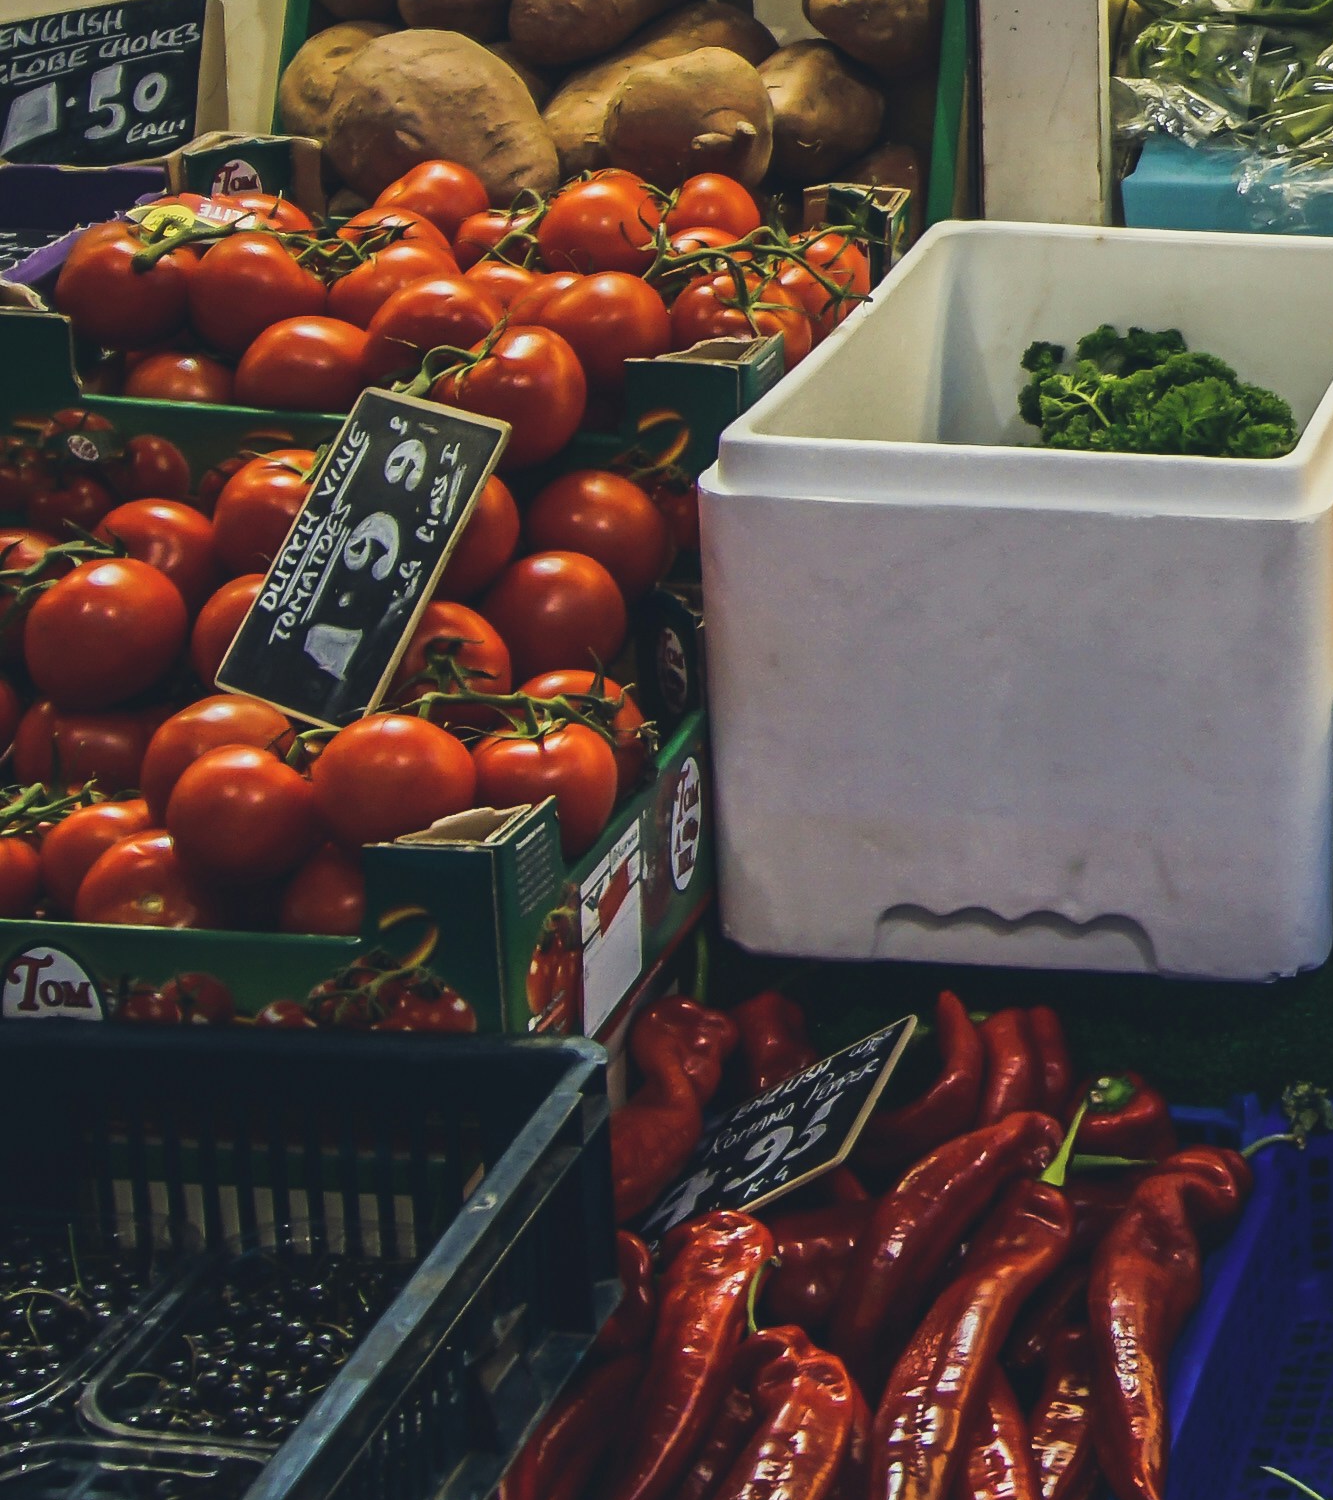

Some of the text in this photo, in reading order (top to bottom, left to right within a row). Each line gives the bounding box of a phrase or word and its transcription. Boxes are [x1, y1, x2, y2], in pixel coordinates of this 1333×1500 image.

[0, 9, 124, 50] ENGLISH
[99, 23, 200, 58] CHOKES
[126, 119, 186, 144] EACH
[259, 421, 365, 612] DUTCH VINE
[269, 499, 352, 644] TOMATOES
